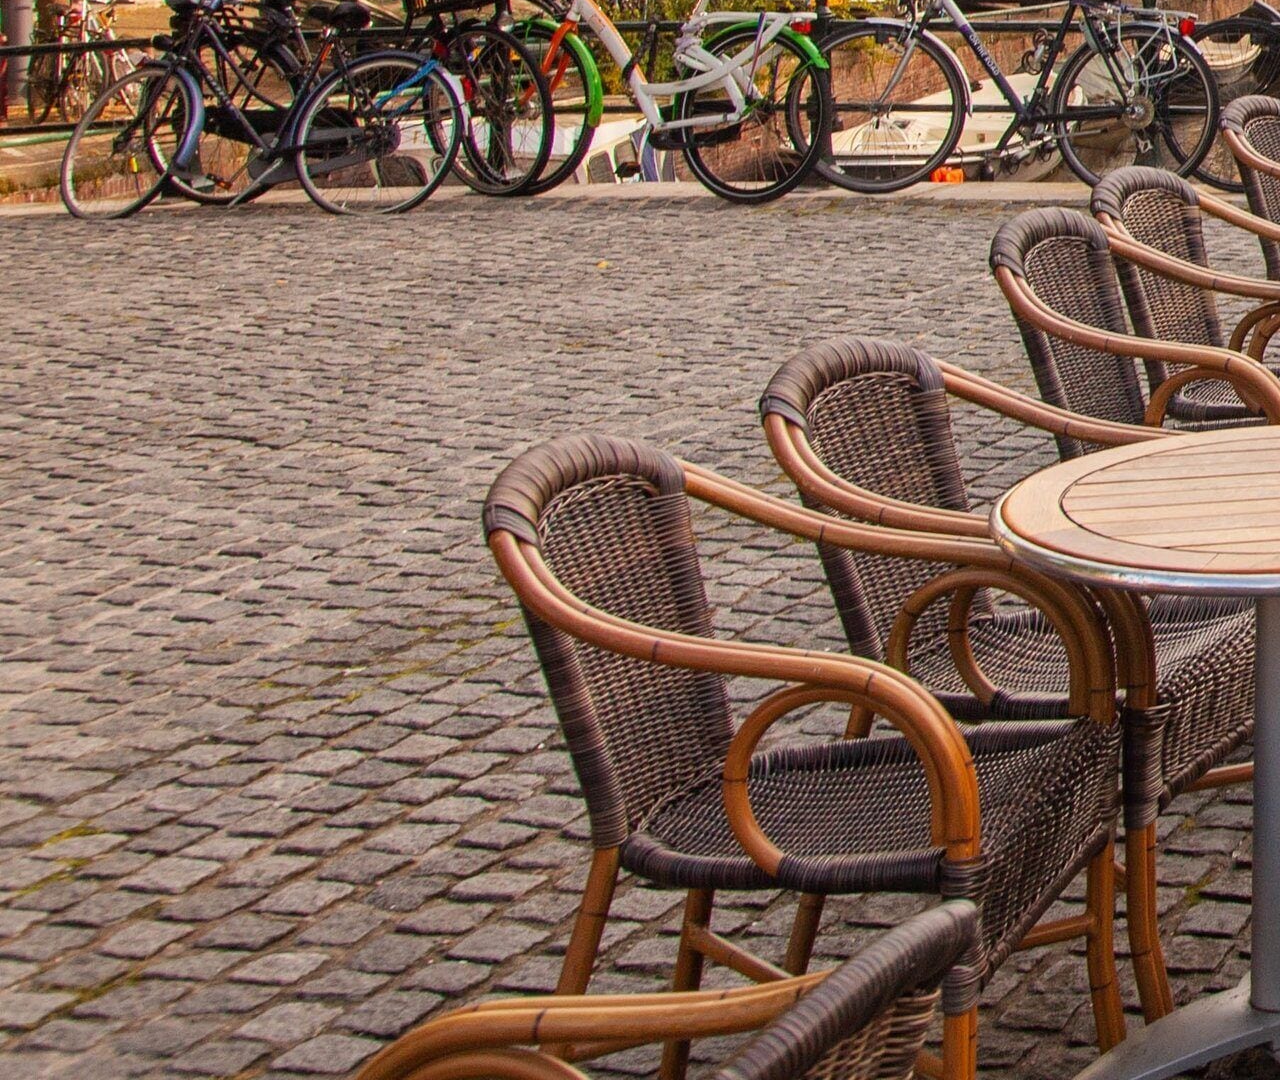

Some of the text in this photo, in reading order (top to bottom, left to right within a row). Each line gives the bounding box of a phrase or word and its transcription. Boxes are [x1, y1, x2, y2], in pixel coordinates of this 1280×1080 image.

[969, 33, 999, 76] ON THE ROAD
